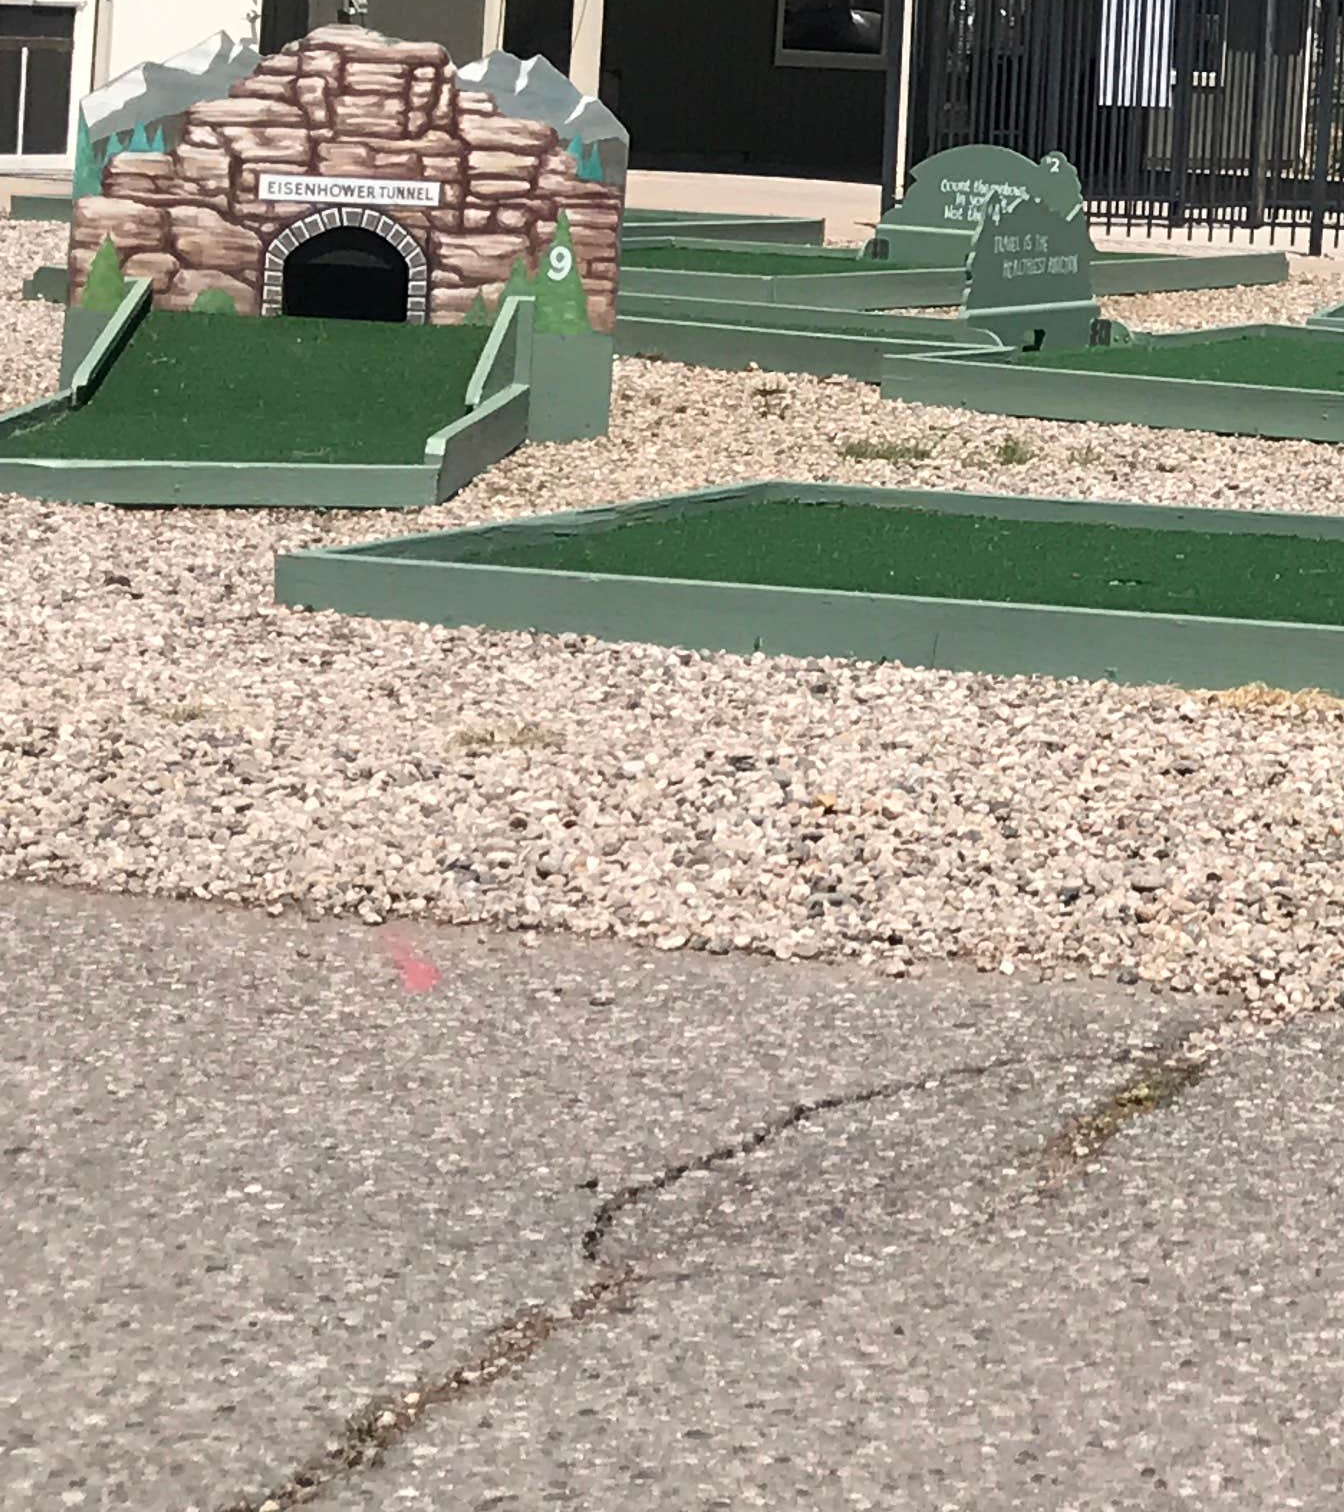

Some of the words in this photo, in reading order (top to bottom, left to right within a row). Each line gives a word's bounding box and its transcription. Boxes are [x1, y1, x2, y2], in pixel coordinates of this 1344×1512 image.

[267, 180, 376, 199] EISENHOWER
[379, 186, 434, 201] TUNNEL
[940, 179, 970, 193] Count
[547, 245, 572, 281] 9
